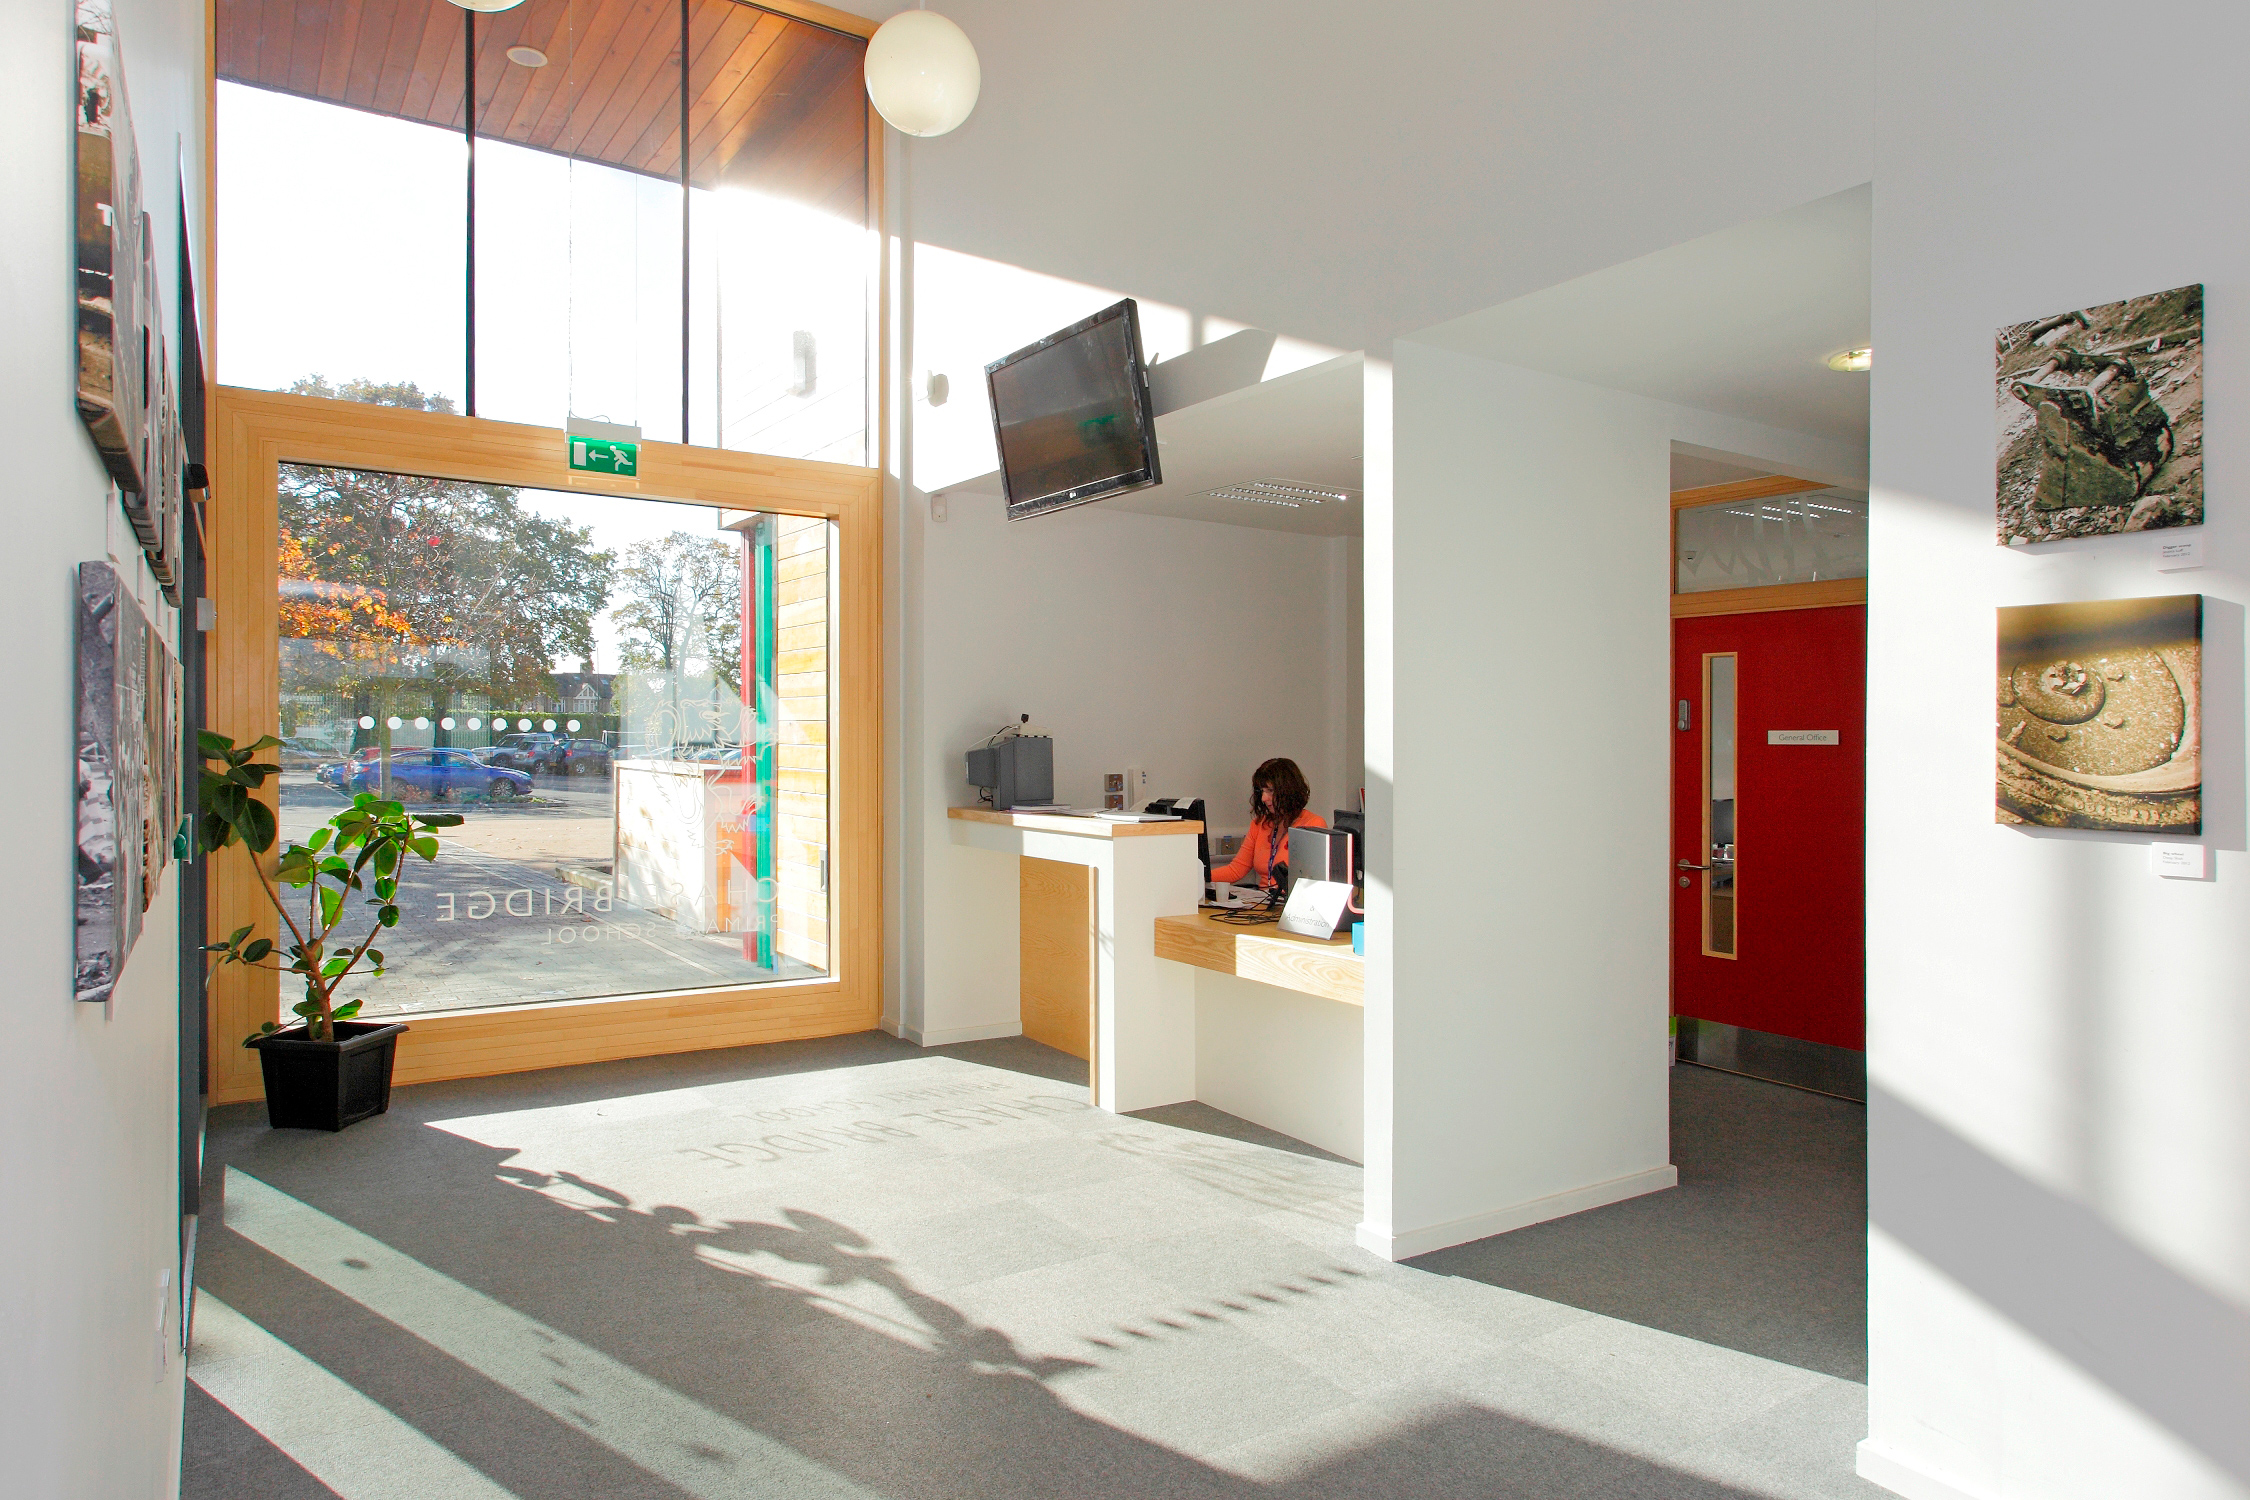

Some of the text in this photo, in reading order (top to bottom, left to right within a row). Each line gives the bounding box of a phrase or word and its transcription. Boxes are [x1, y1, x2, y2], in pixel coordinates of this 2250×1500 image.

[1778, 733, 1828, 742] General Office
[1286, 913, 1331, 928] Administration
